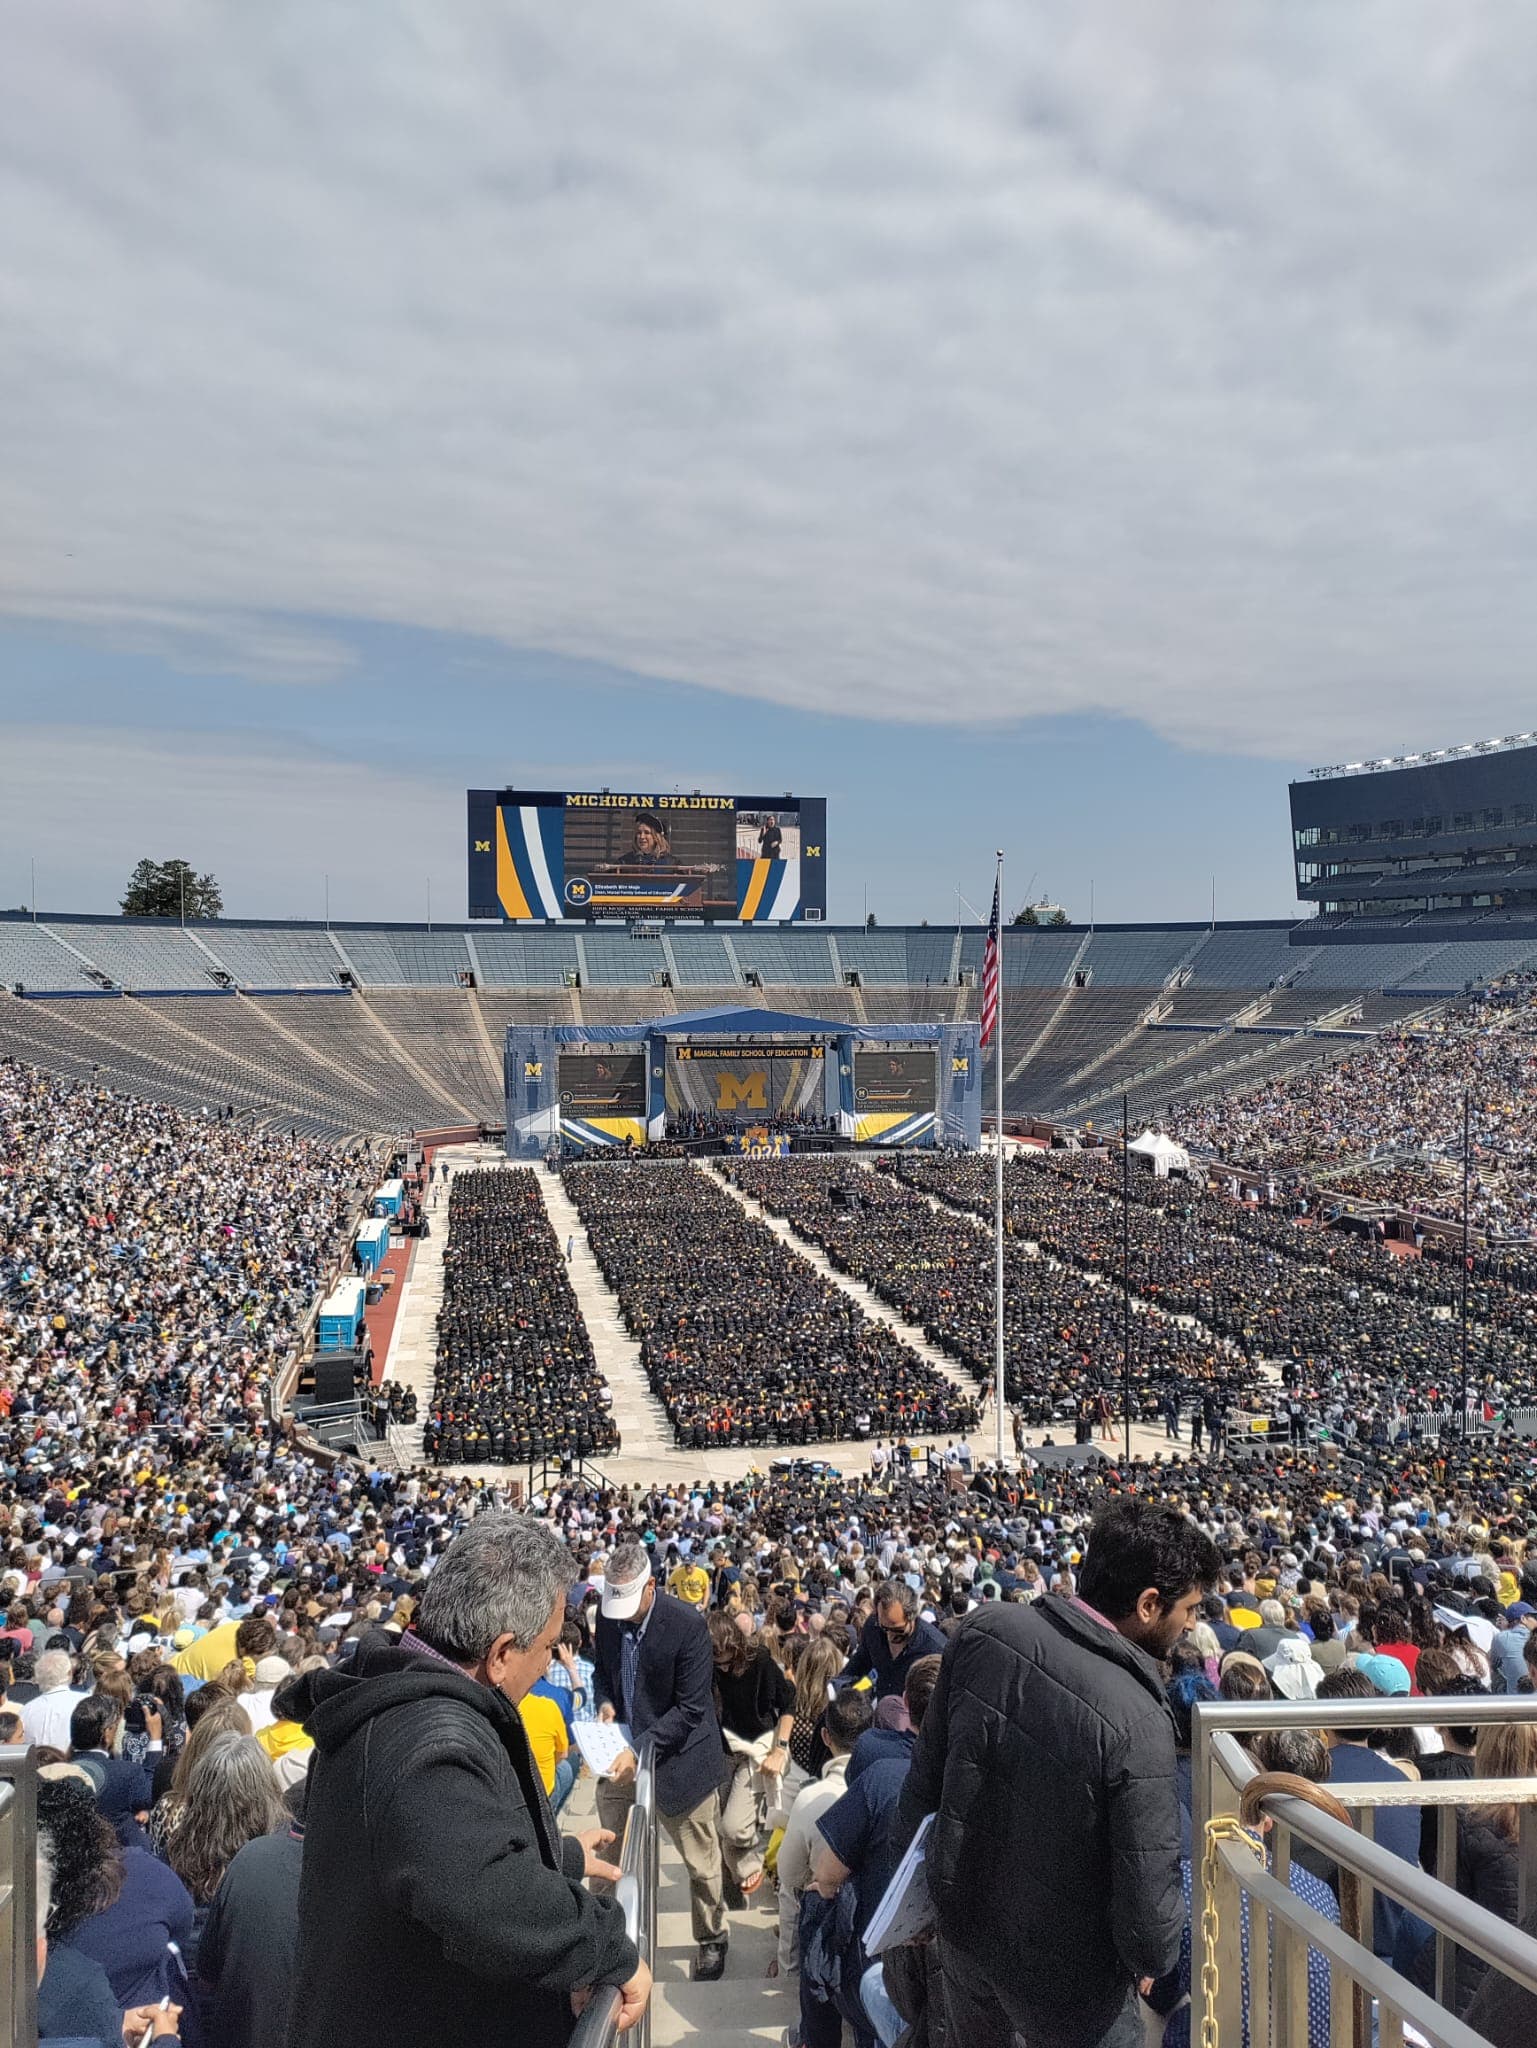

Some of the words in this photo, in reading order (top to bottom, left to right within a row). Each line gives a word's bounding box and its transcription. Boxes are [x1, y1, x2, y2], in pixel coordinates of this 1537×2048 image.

[566, 794, 654, 808] MICHIGAN
[659, 796, 734, 809] STADIUM
[474, 840, 491, 852] M
[806, 846, 821, 857] M
[572, 884, 585, 895] M
[678, 1047, 692, 1060] M
[694, 1049, 719, 1057] MARSAL
[720, 1049, 740, 1057] FAMILY
[741, 1049, 765, 1057] SCHOOL
[766, 1049, 774, 1057] OF
[775, 1049, 808, 1057] EDUCATION
[811, 1047, 823, 1059] M
[525, 1062, 542, 1076] M
[951, 1057, 969, 1071] M
[716, 1072, 767, 1110] M
[741, 1144, 782, 1160] 2024
